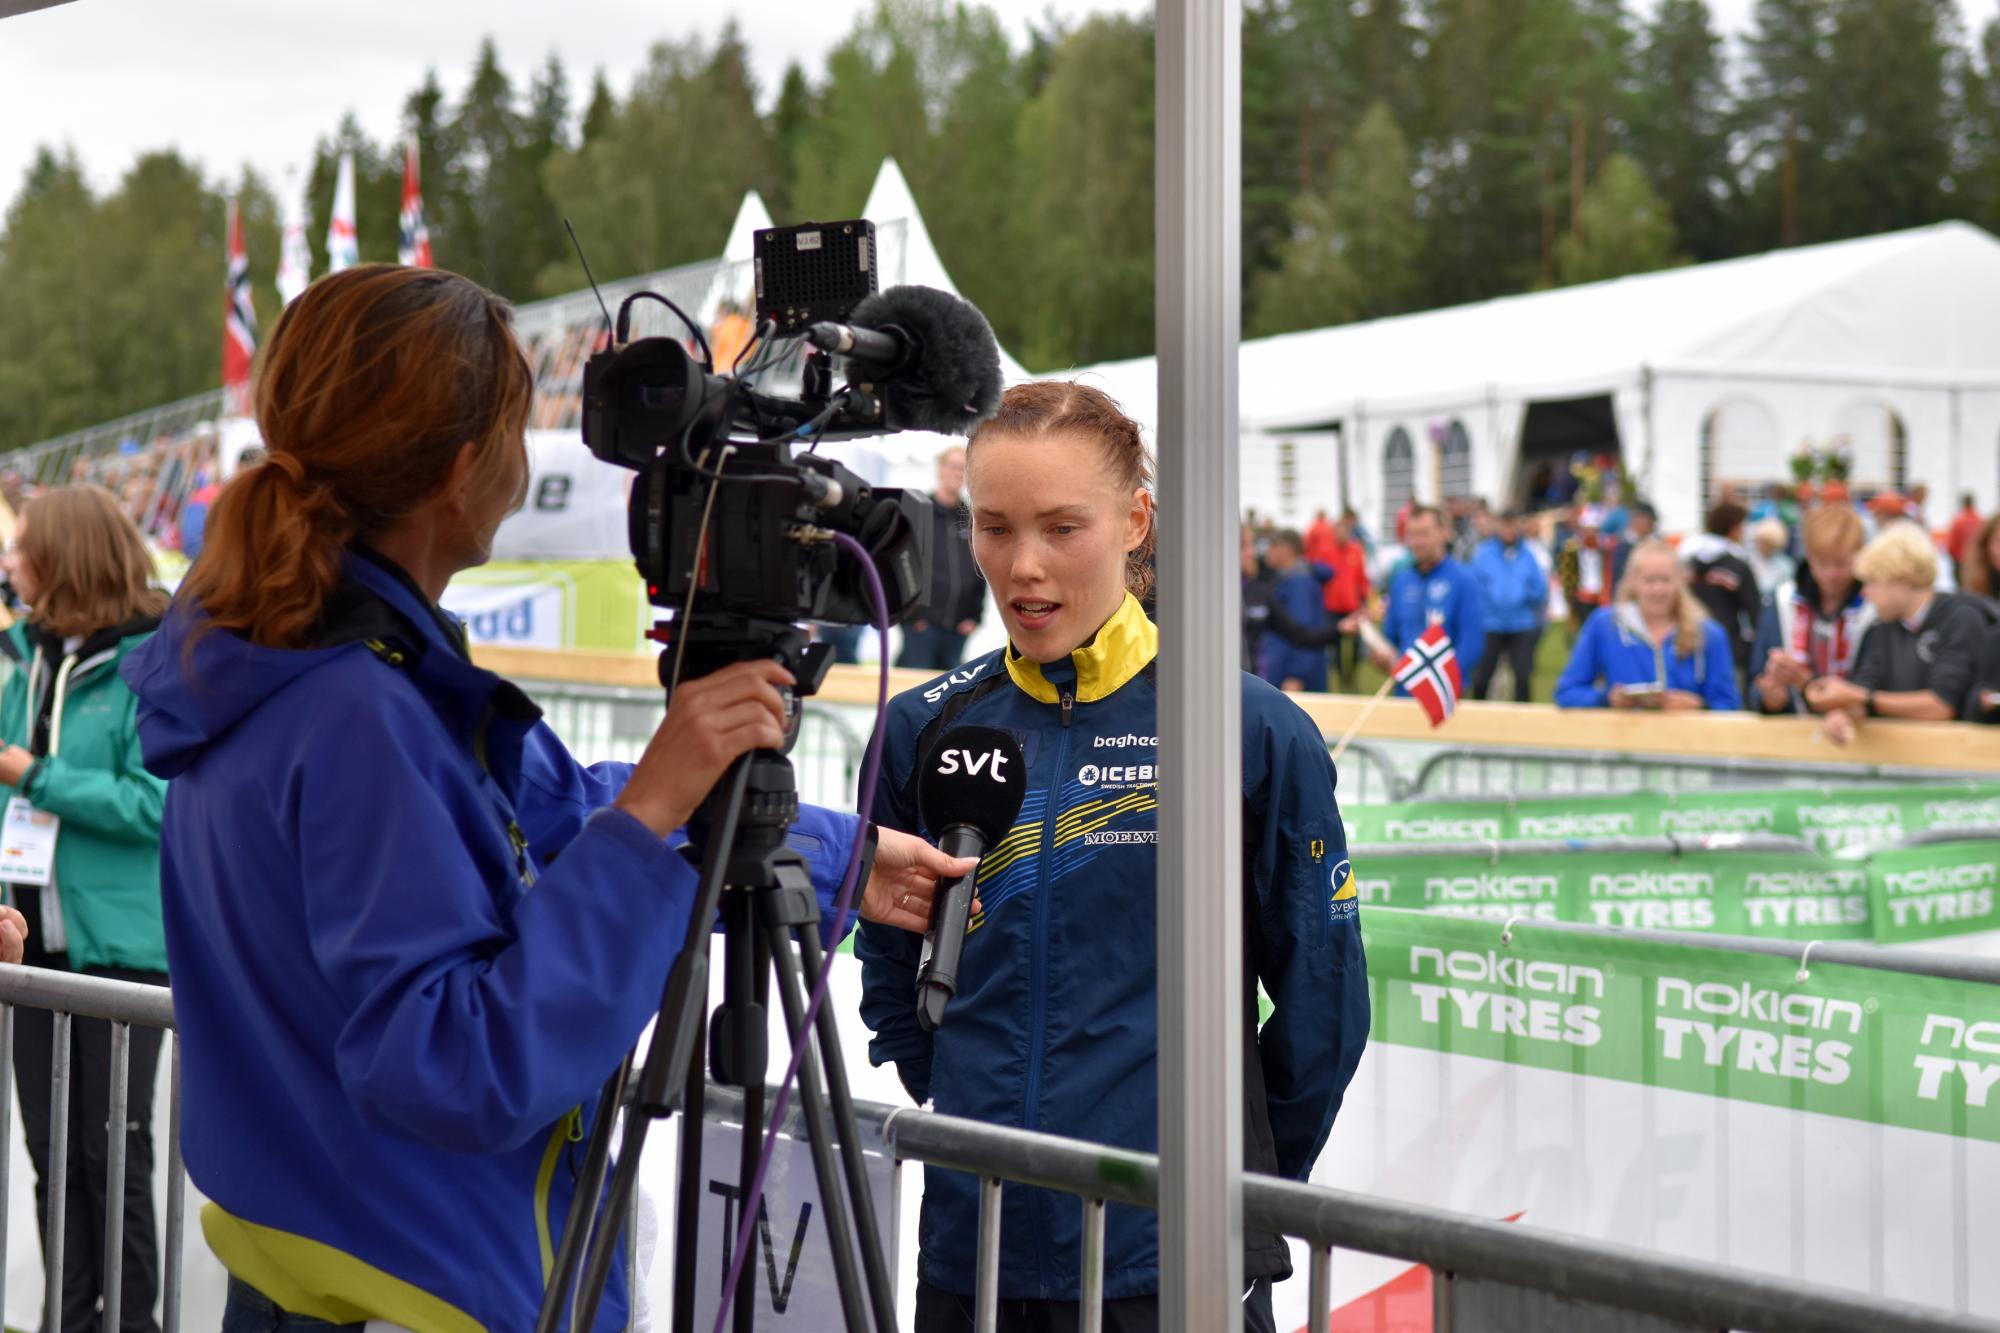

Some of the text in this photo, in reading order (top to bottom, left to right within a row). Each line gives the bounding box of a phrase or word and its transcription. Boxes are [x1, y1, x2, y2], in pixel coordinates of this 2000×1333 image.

[937, 748, 1009, 783] svt
[1424, 874, 1557, 900] nokian
[1590, 870, 1712, 896] nokian
[1744, 870, 1867, 894] nokian
[1589, 900, 1715, 928] TYRES
[1744, 896, 1868, 927] TYRES
[1888, 888, 1993, 926] TYRES
[1410, 945, 1604, 998] nokian
[1410, 983, 1603, 1047] TYRES
[1657, 976, 1862, 1034] nokian
[1655, 1016, 1853, 1086] TYRES
[1913, 1054, 2000, 1107] TY
[708, 1179, 813, 1314] TV
